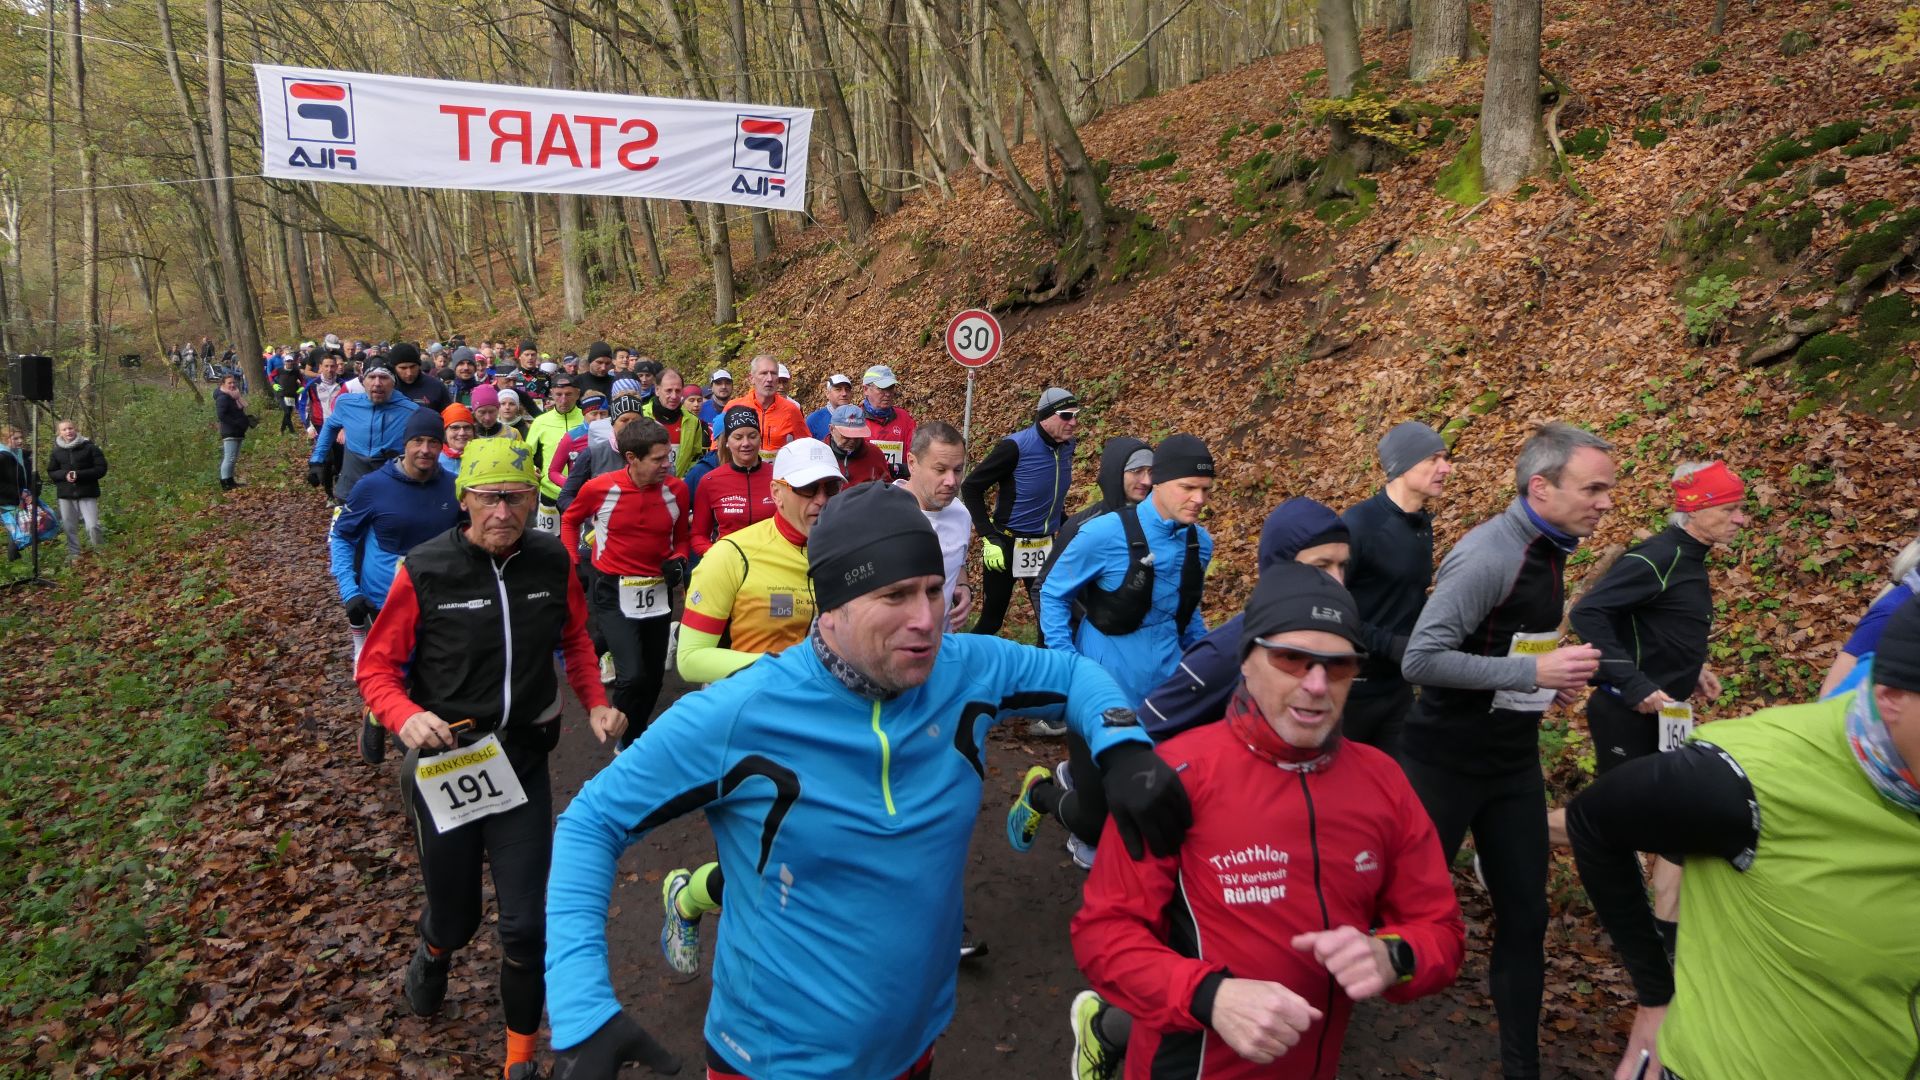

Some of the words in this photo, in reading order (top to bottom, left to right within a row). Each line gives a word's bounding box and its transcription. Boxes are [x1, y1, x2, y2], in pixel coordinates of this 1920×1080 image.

[957, 325, 990, 352] 30
[720, 495, 747, 503] Triathlon
[1020, 550, 1046, 569] 339
[844, 561, 875, 581] GORE
[635, 589, 656, 609] 16
[439, 768, 504, 810] 191
[1208, 843, 1290, 871] Triathlon
[1217, 873, 1239, 885] TSV
[1241, 867, 1287, 885] Karlstadt
[1223, 884, 1287, 905] Rüdiger
